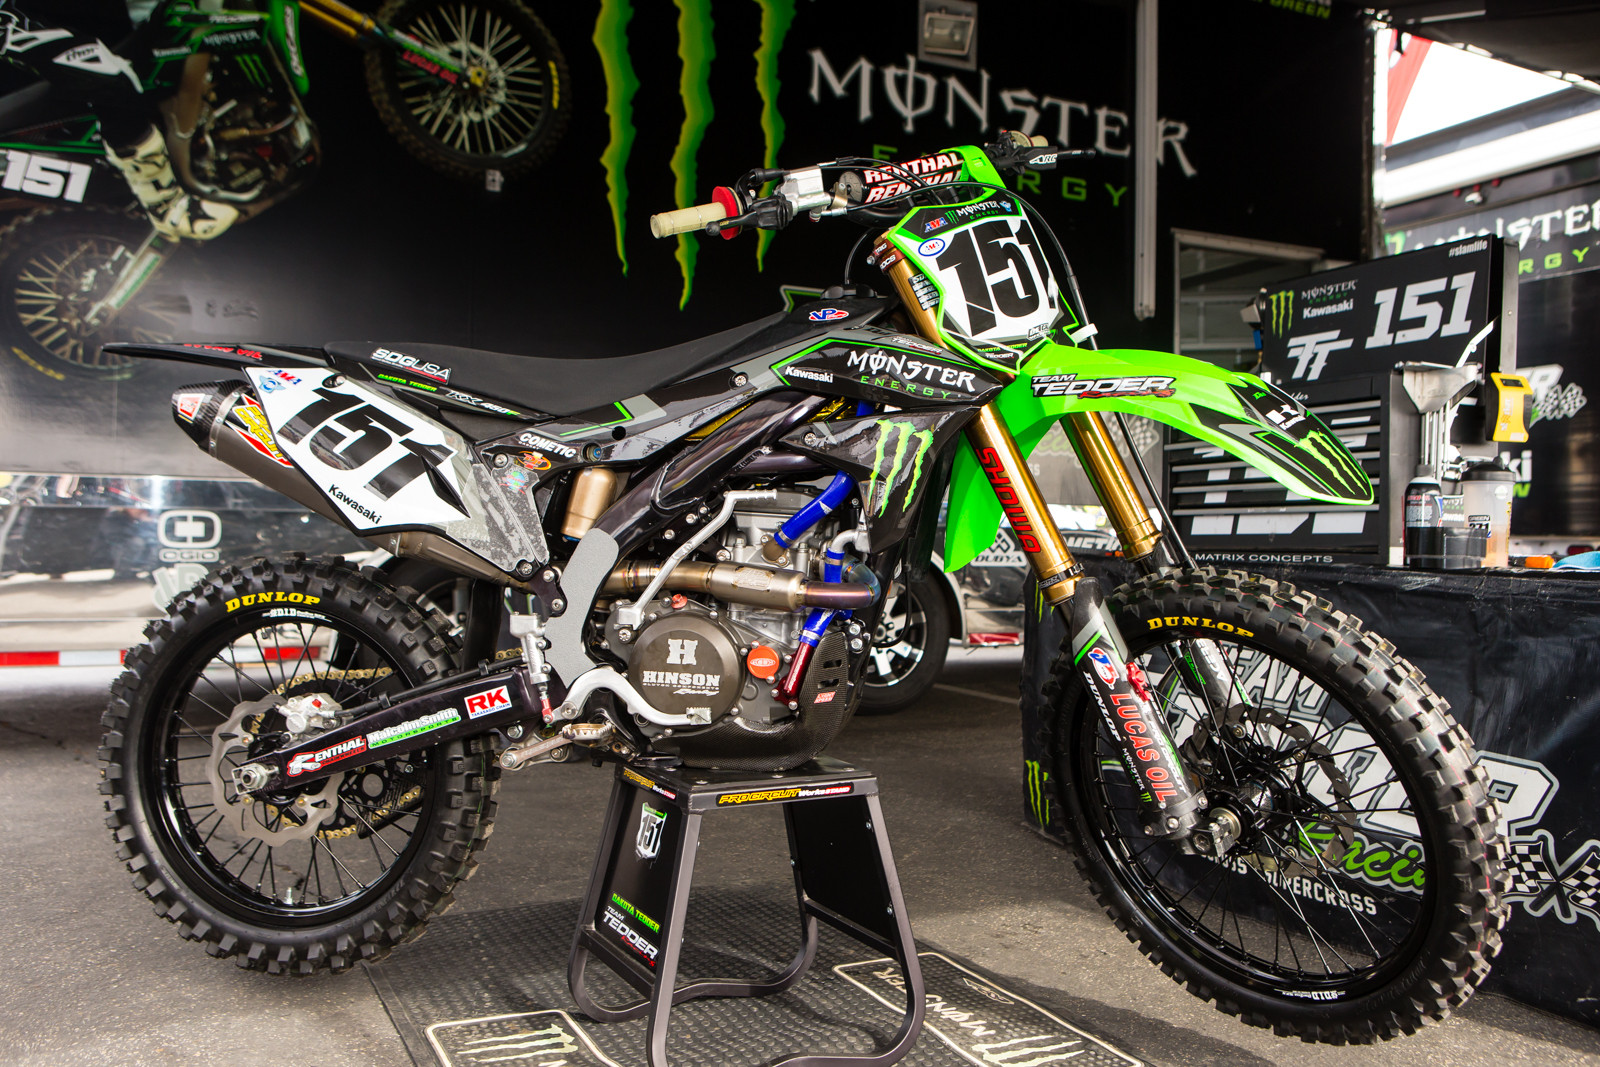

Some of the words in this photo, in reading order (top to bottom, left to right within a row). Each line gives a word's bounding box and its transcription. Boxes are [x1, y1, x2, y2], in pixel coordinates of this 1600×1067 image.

[808, 48, 1198, 178] MONSTER
[2, 150, 92, 203] 151
[863, 152, 966, 184] RENTHAL
[956, 200, 1000, 217] MONSTER
[924, 216, 949, 234] AMA
[1518, 247, 1590, 275] RGY
[935, 218, 1057, 338] 151
[1301, 279, 1358, 300] MONSTER
[1302, 299, 1354, 319] Kawasaki
[1364, 271, 1476, 350] 151
[377, 373, 407, 385] DAKOTA
[408, 380, 438, 393] TEDDER
[784, 366, 834, 384] Kawasaki
[847, 350, 977, 393] MONSTER
[1032, 374, 1077, 383] TEAM
[860, 375, 952, 400] ENERGY
[1032, 377, 1176, 397] TEDDER
[275, 387, 460, 502] 151
[519, 432, 577, 458] COMETIC
[327, 483, 384, 525] Kawasaki
[975, 446, 1042, 554] SHOWA
[161, 549, 219, 562] OGIO
[974, 554, 1024, 563] DUBYA
[1194, 553, 1245, 561] MATRIX
[1248, 554, 1334, 563] CONCEPTS
[224, 591, 321, 613] DUNLOP
[1146, 615, 1255, 639] DUNLOP
[666, 638, 699, 666] H
[642, 670, 721, 687] HINSON
[466, 687, 509, 714] RK
[1082, 670, 1122, 742] DUNLOP
[1109, 693, 1162, 762] LUCAS
[1145, 766, 1178, 802] OIL
[1121, 747, 1146, 791] MONSTER
[638, 815, 664, 854] 151
[606, 905, 625, 921] TEAM
[611, 892, 635, 916] DAKOTA
[634, 909, 660, 934] TEDDER
[603, 910, 659, 960] TEDDER
